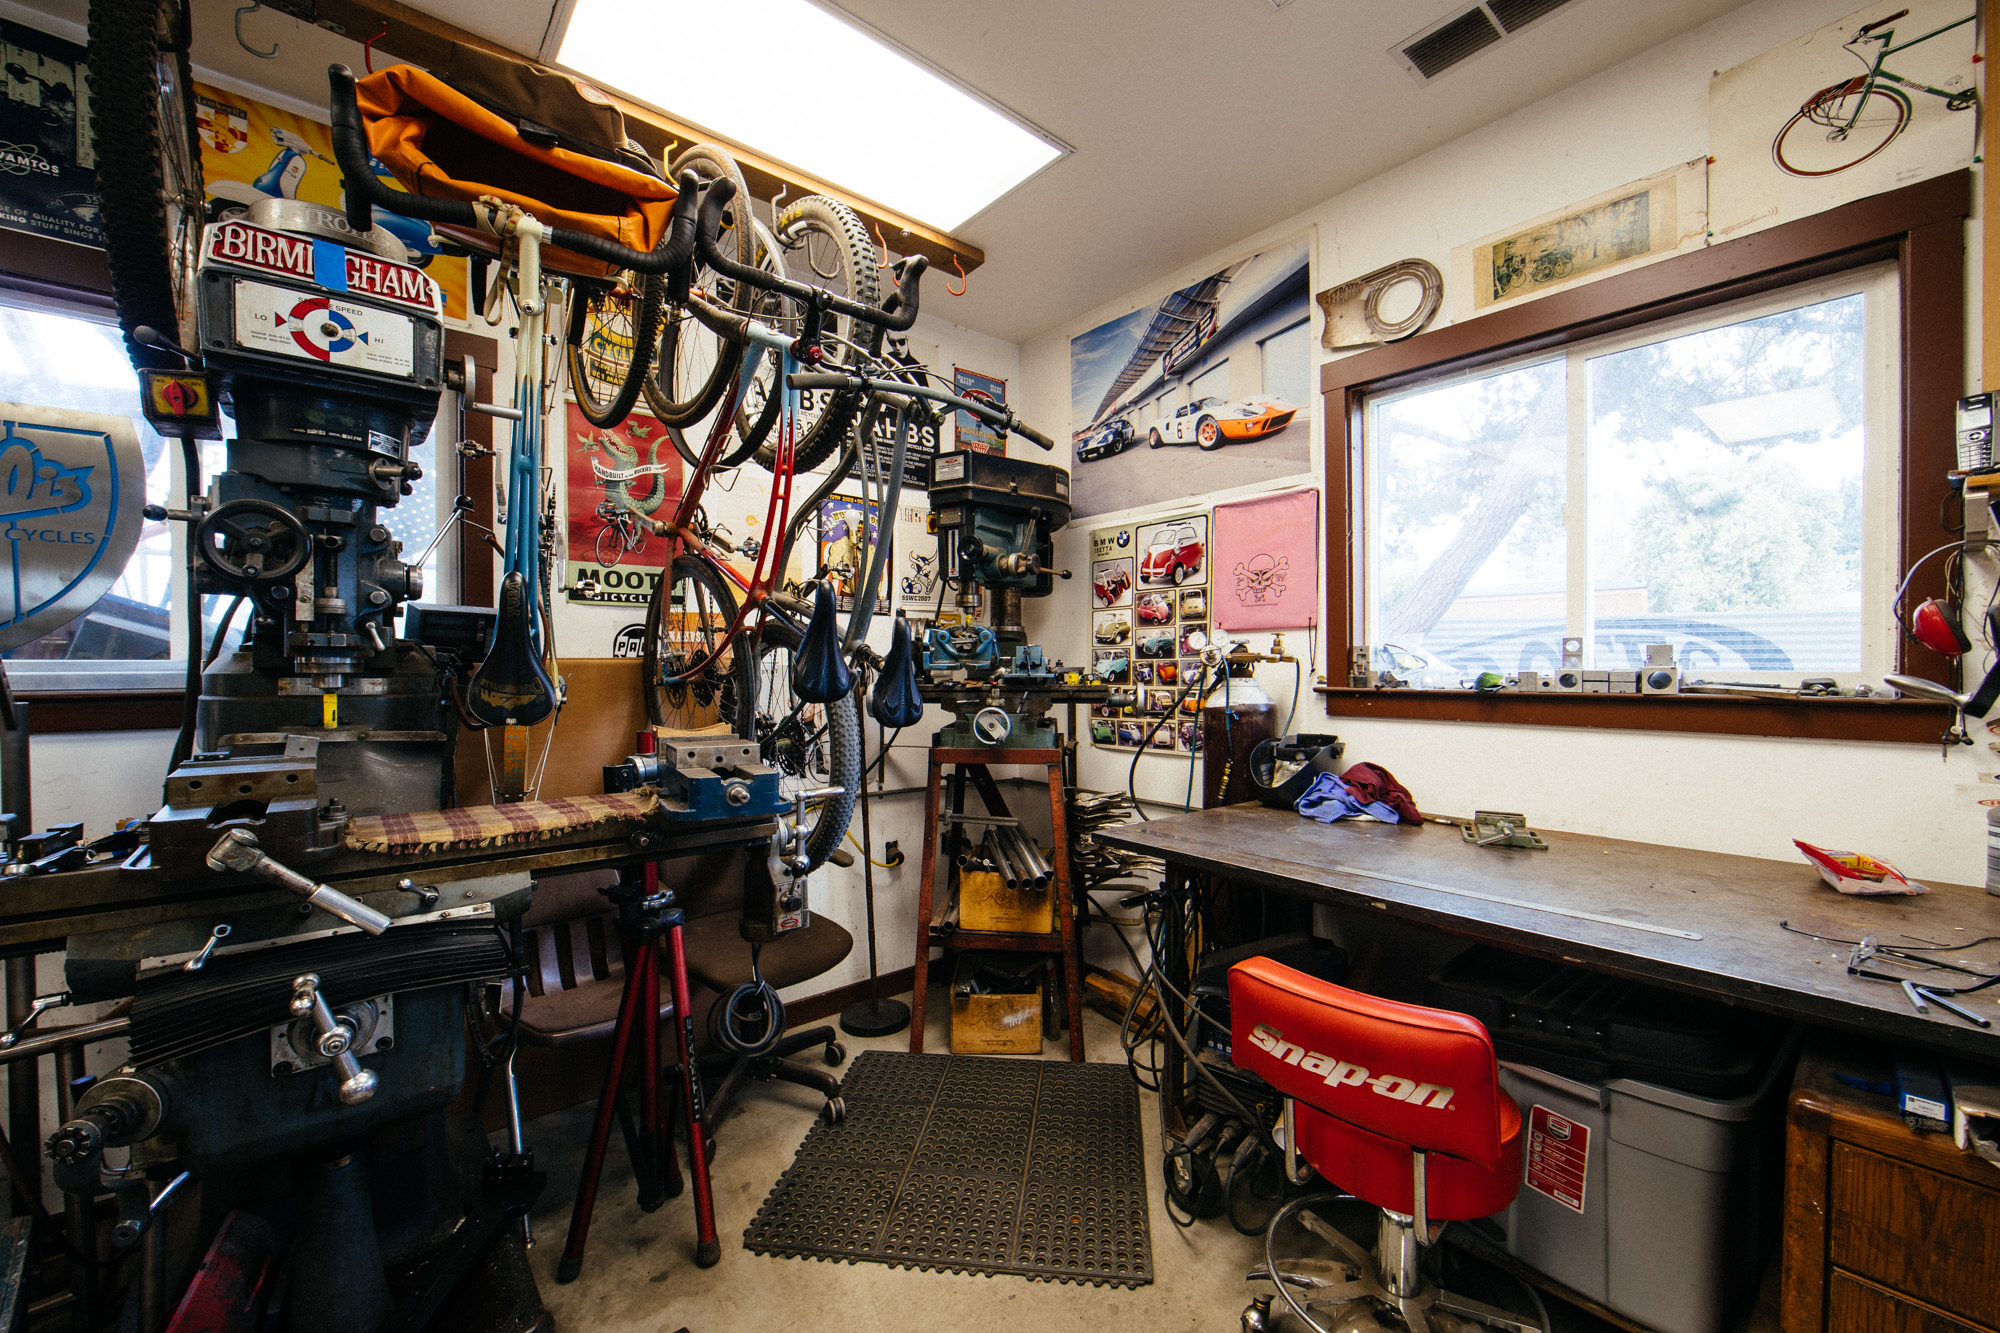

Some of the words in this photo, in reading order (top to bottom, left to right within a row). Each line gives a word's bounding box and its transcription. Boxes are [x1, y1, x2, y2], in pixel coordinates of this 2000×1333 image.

[0, 213, 27, 224] KING
[30, 220, 60, 231] STUFF
[63, 227, 94, 240] SINCE
[14, 208, 28, 216] OF
[32, 212, 75, 228] QUALITY
[80, 223, 100, 234] FOR
[222, 225, 426, 302] BIRMIGHAM
[254, 313, 268, 321] LO
[297, 296, 334, 311] SPINDLE
[336, 305, 363, 317] SPEED
[1177, 422, 1183, 439] 6
[594, 463, 624, 479] HANDBUILT
[634, 466, 652, 475] ROCKIES
[5, 528, 96, 544] CYCLES
[577, 568, 662, 590] MOOT
[507, 581, 521, 617] YUBA
